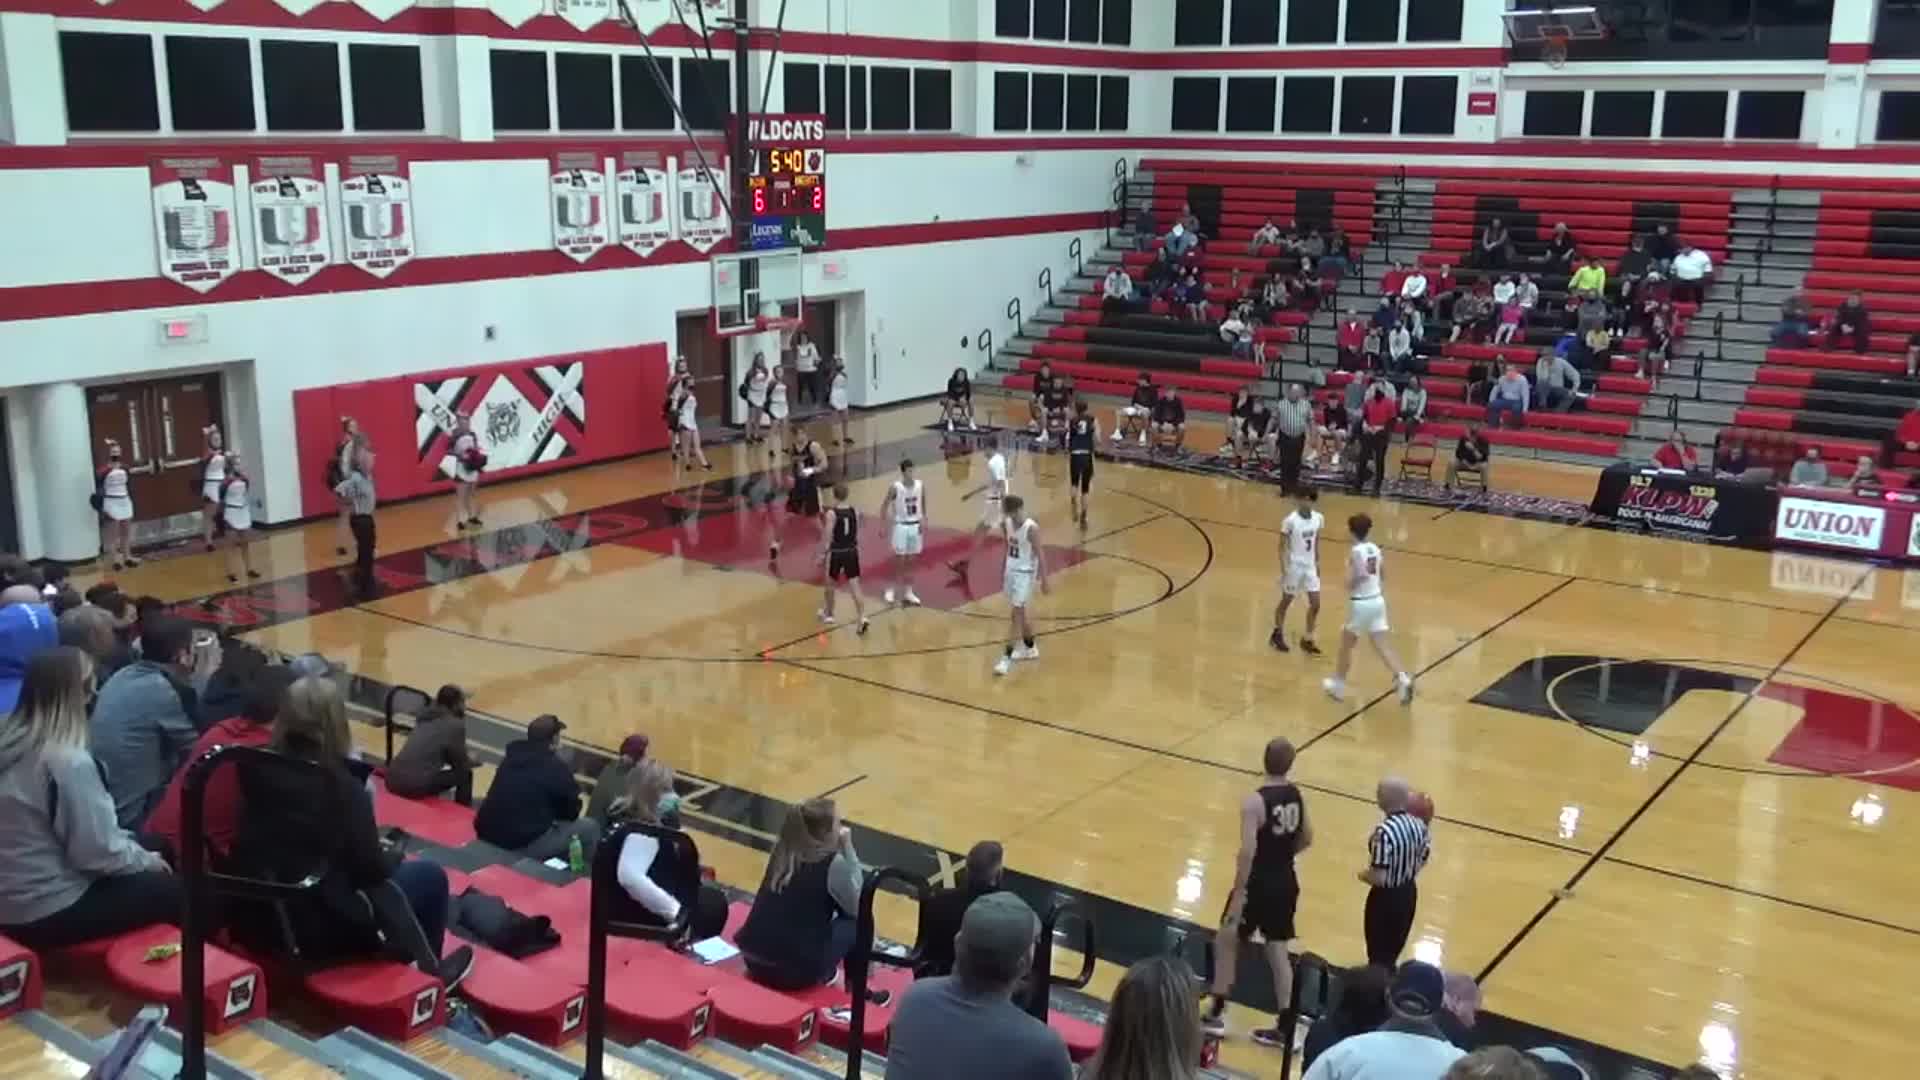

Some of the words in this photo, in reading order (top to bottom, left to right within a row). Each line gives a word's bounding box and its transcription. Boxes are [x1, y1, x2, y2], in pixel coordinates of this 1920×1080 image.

[770, 150, 802, 173] 5:40
[754, 188, 765, 212] 6
[813, 186, 823, 209] 2
[843, 517, 850, 537] 1
[1783, 507, 1877, 538] UNION
[1272, 803, 1299, 835] 30
